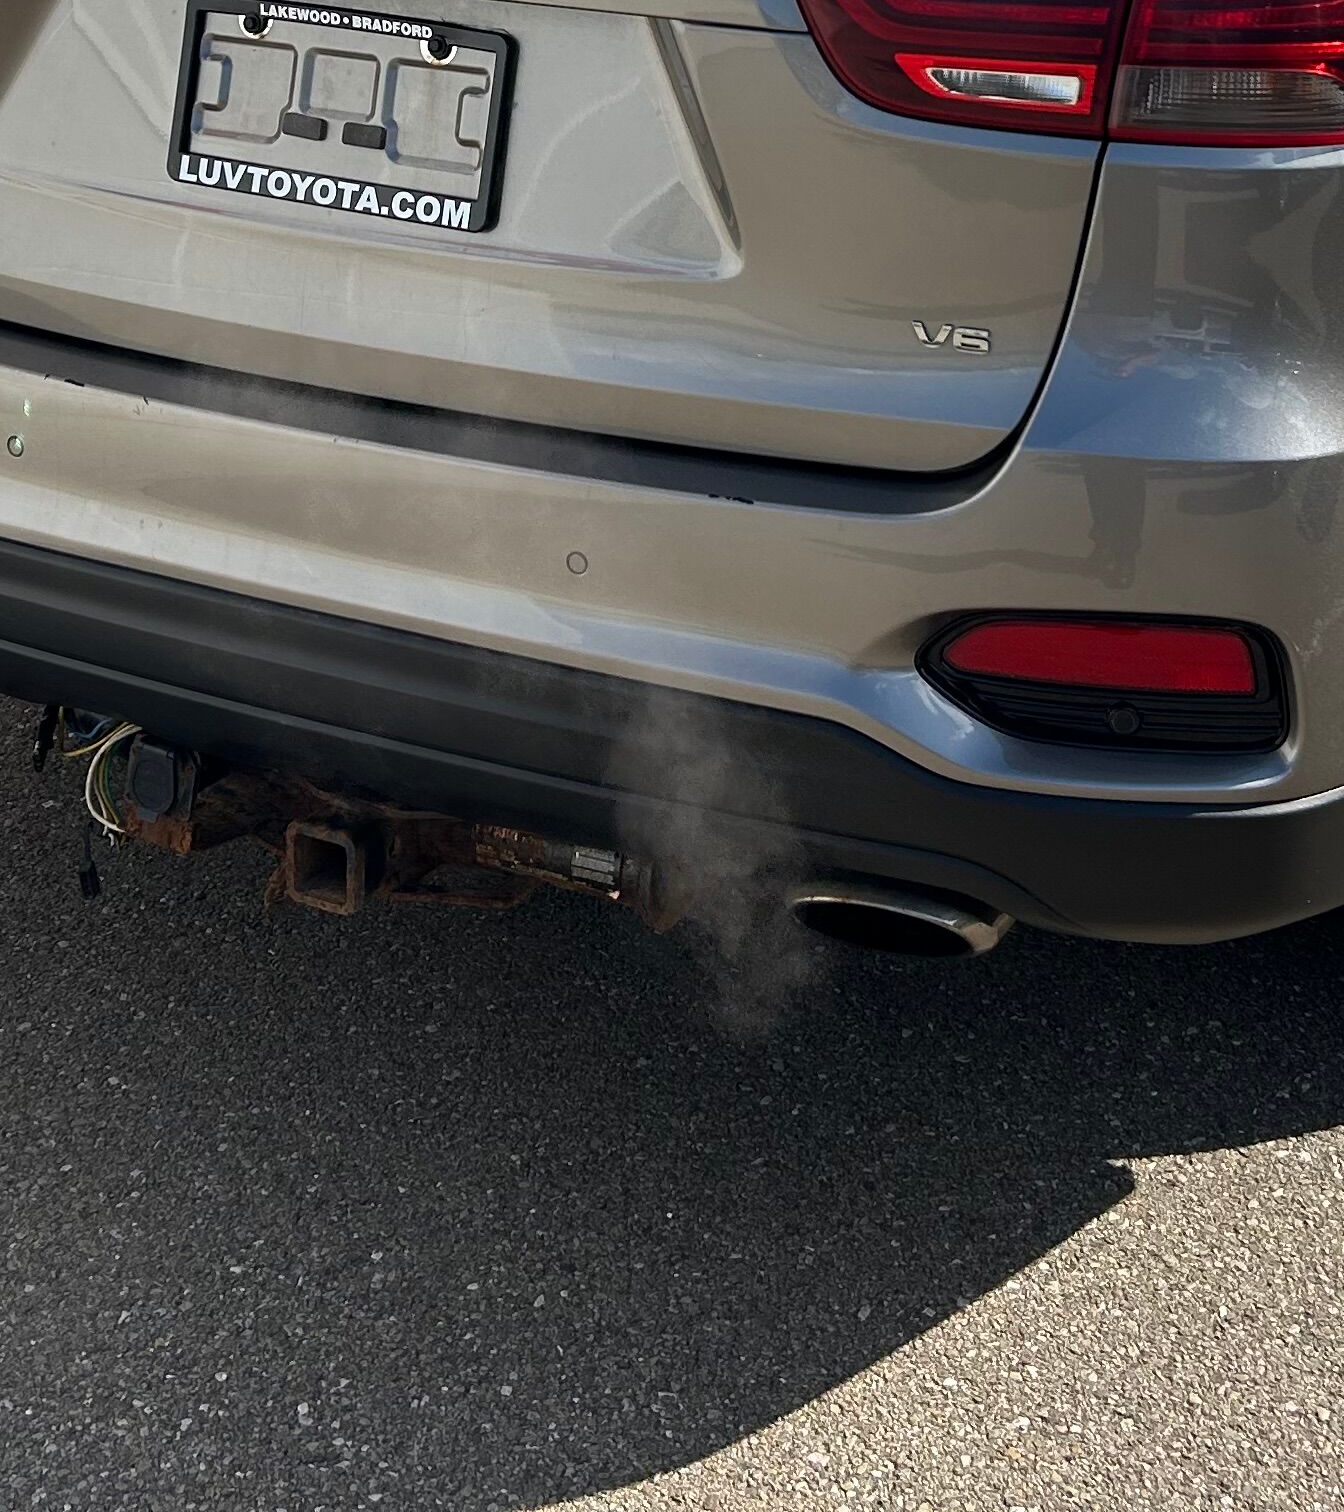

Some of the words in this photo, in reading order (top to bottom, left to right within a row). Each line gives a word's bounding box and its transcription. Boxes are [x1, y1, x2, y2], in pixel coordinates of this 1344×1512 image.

[259, 3, 341, 26] LAKEWOOD
[352, 15, 433, 40] BRADFORD
[179, 155, 472, 230] LUVTOYOTA.COM
[912, 319, 991, 356] V6
